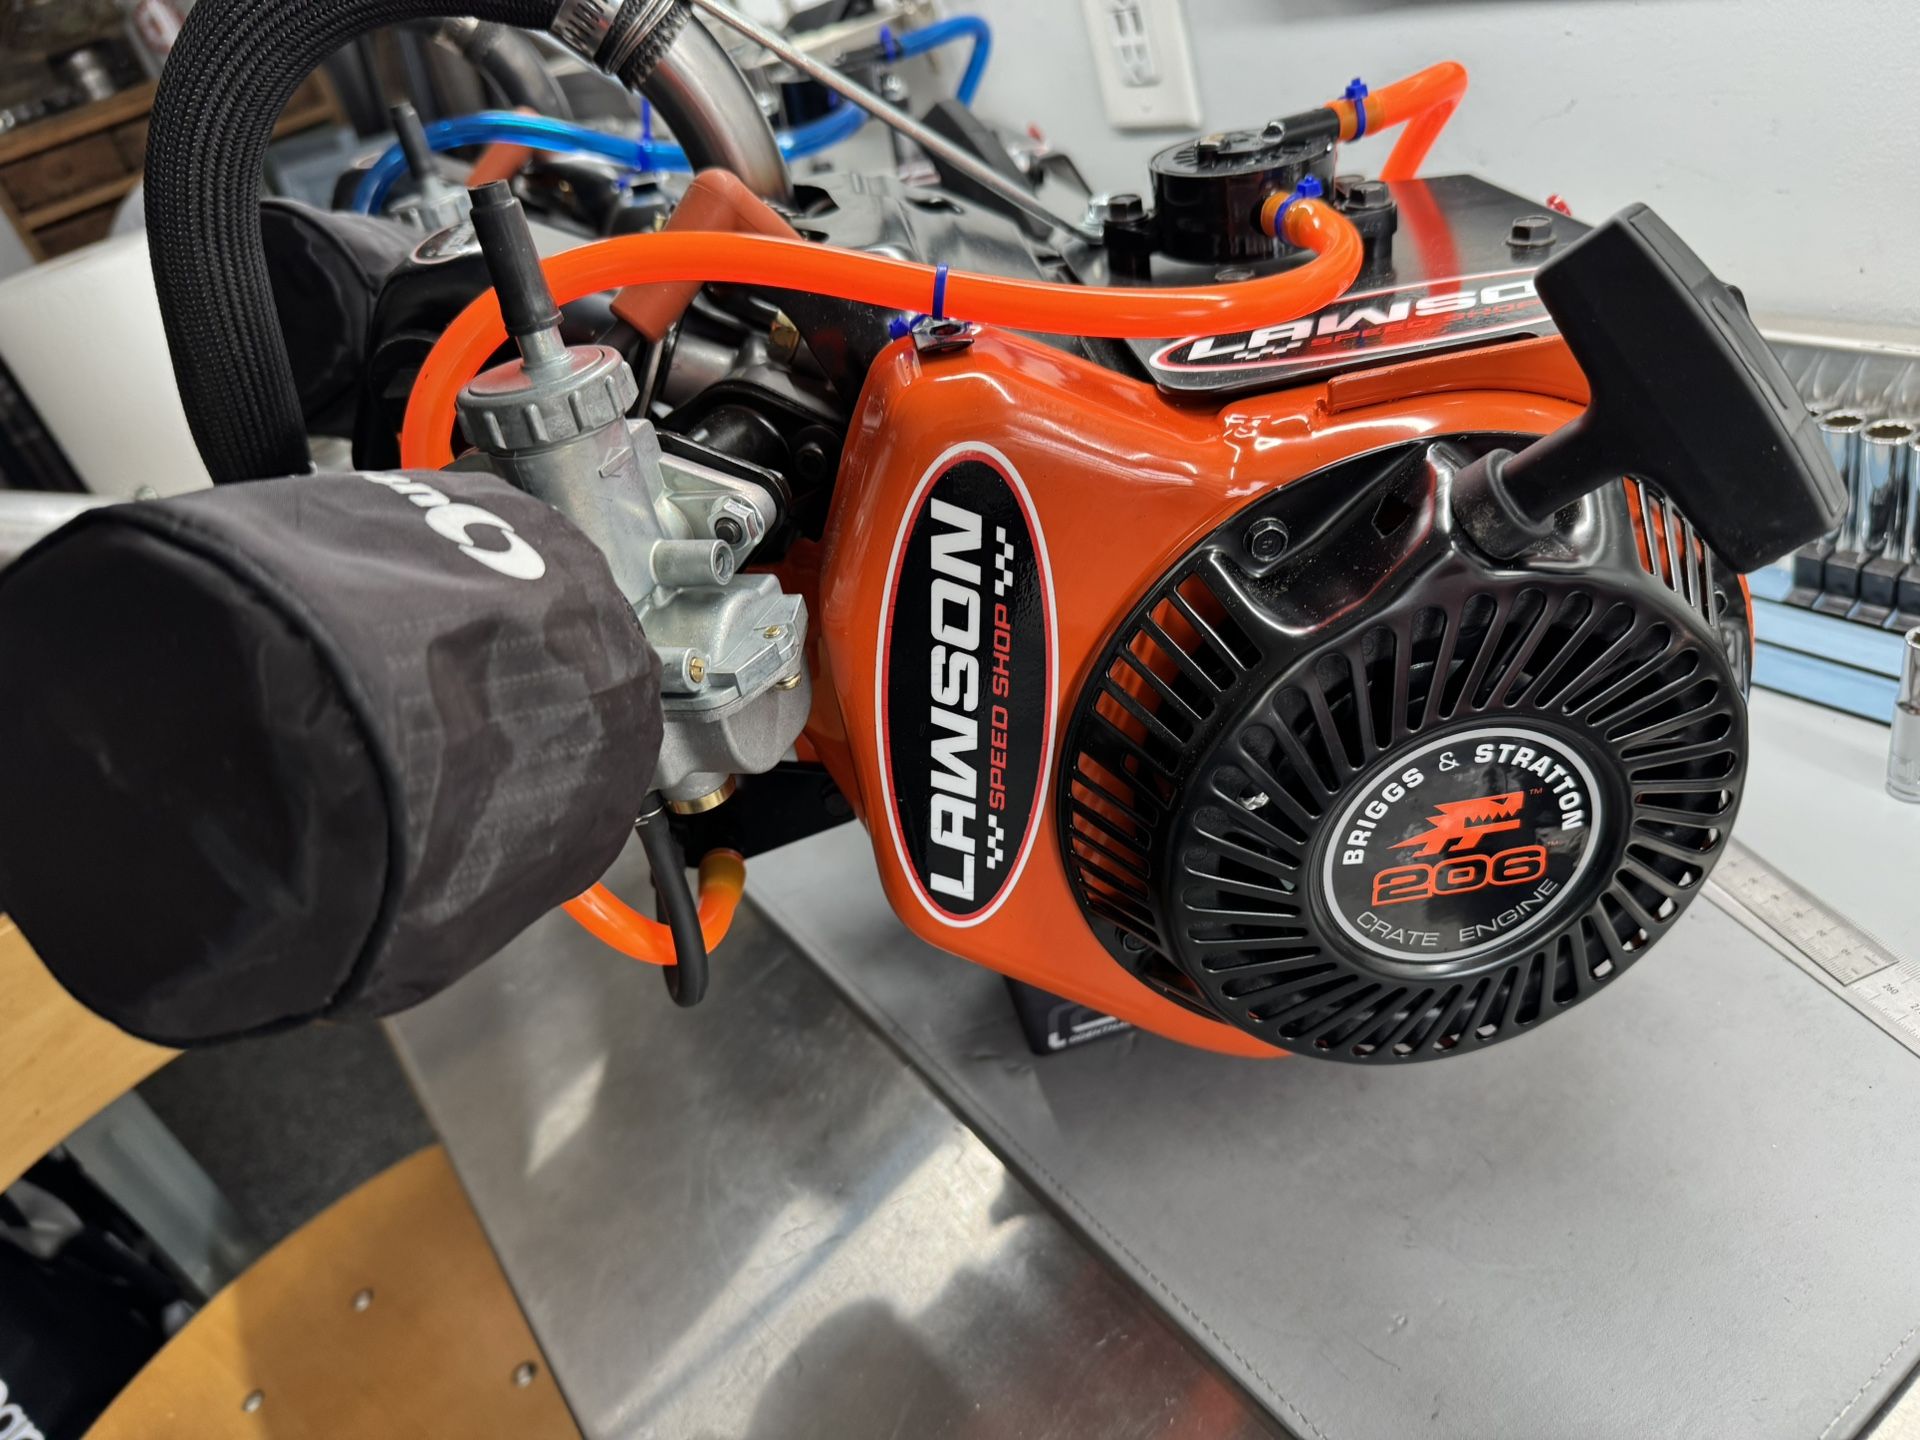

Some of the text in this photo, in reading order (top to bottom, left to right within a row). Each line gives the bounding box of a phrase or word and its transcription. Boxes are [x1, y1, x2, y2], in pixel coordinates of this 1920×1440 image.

[1187, 280, 1538, 361] LAWSO
[930, 497, 983, 902] LAWSON
[989, 603, 1011, 811] SPEED SHOP
[1342, 743, 1586, 866] BRIGGS & STRATTON
[1356, 877, 1559, 947] CRATE ENGINE
[1371, 844, 1548, 907] 206
[1882, 983, 1900, 995] 260
